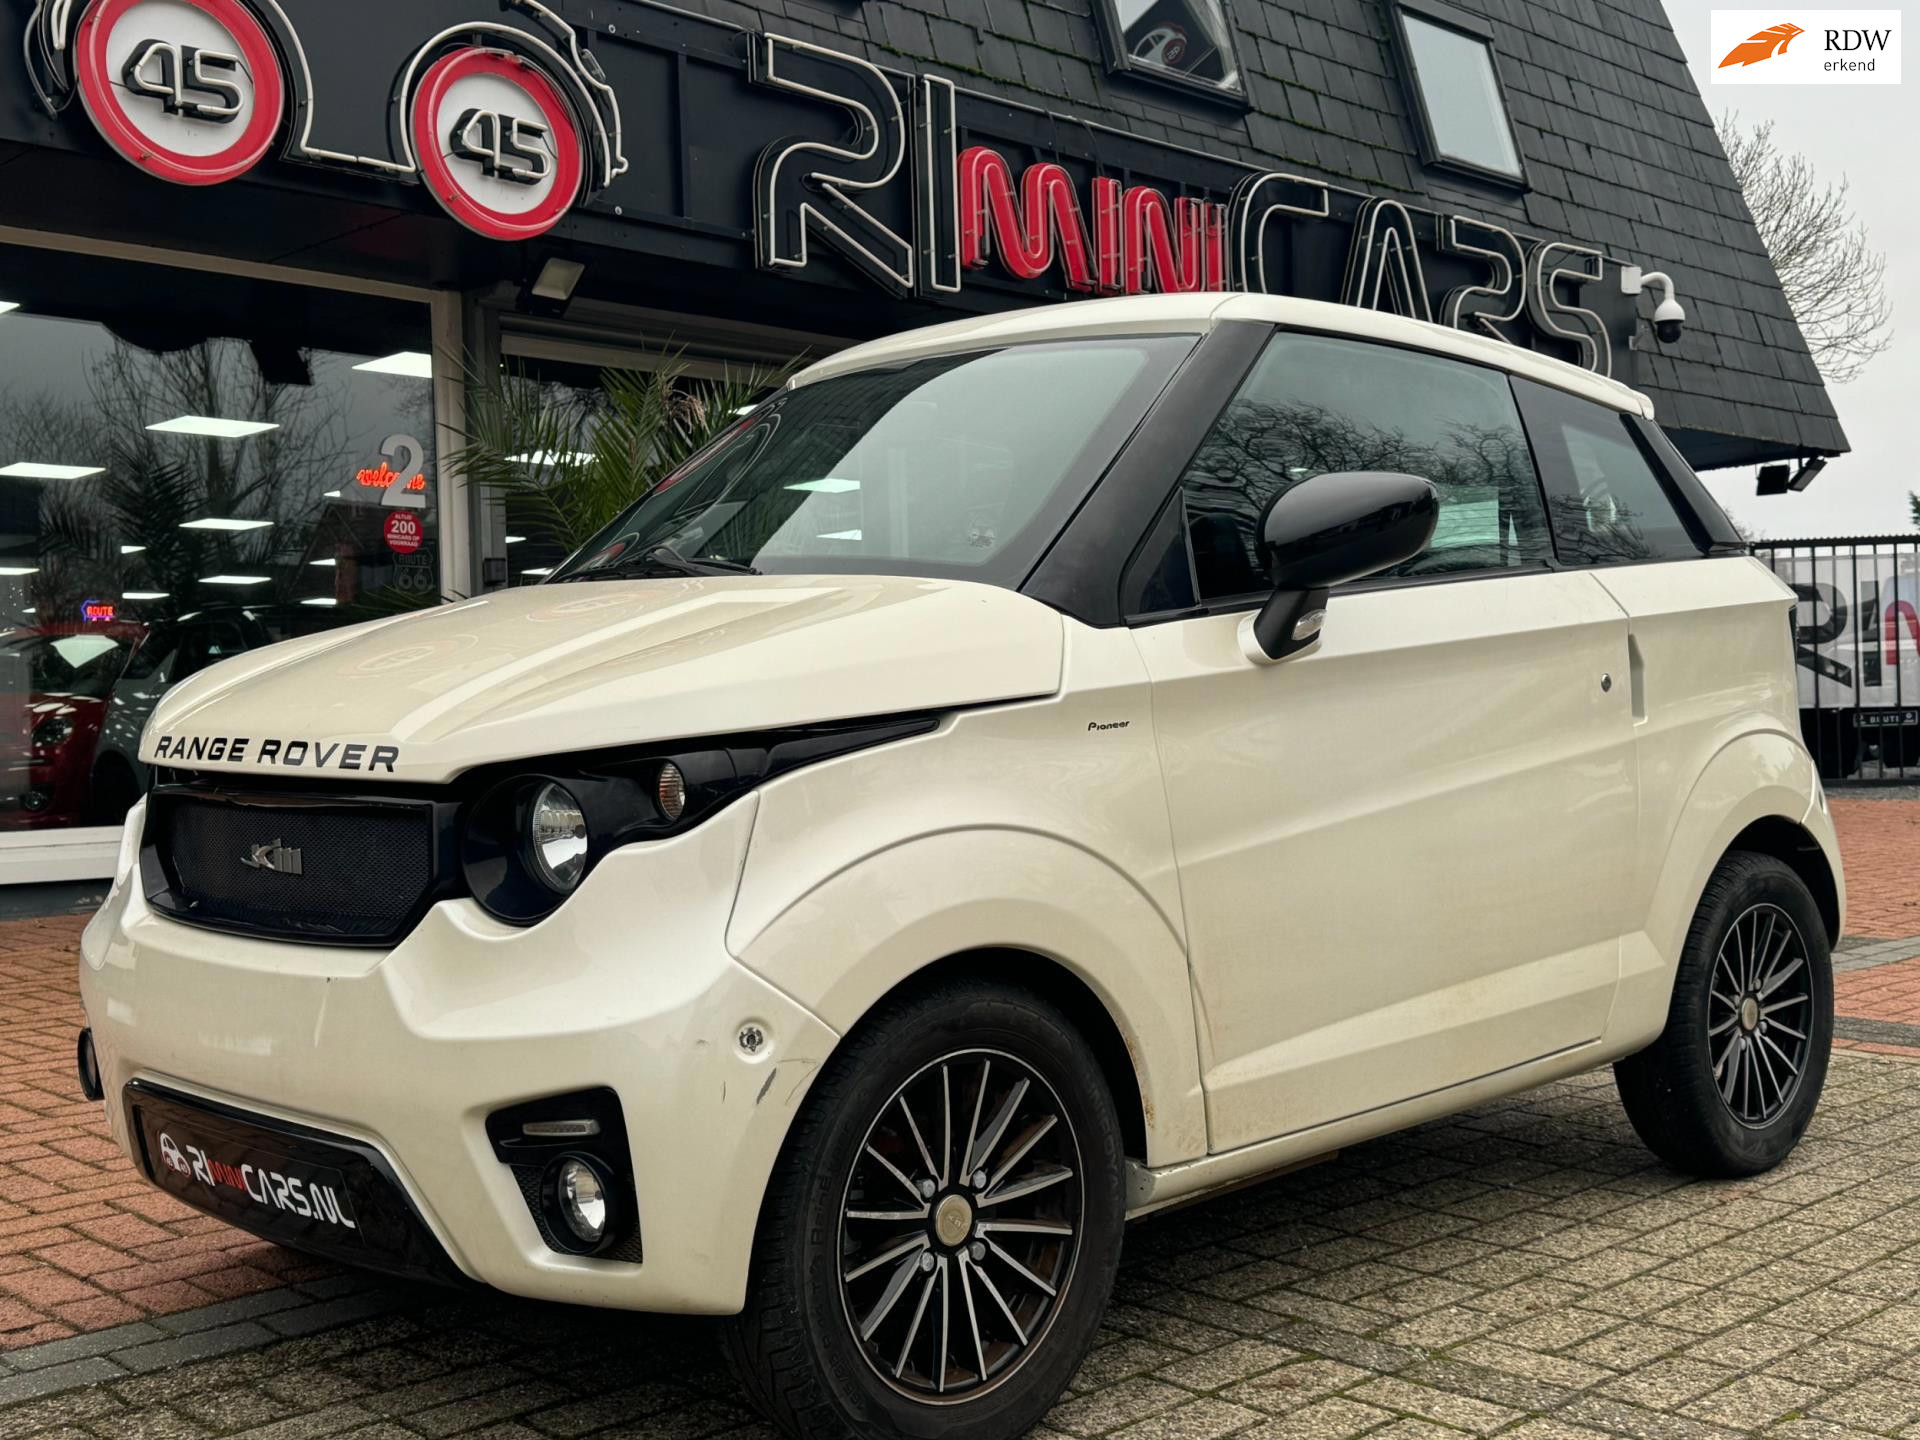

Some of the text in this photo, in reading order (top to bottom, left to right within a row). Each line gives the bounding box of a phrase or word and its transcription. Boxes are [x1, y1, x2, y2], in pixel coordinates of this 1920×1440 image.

[121, 39, 243, 124] 45
[449, 108, 551, 186] 45
[381, 433, 426, 508] 2
[391, 519, 416, 535] 200
[86, 605, 114, 617] ROUTE
[1087, 720, 1130, 732] Pioneer
[154, 735, 400, 774] RANGE ROVER
